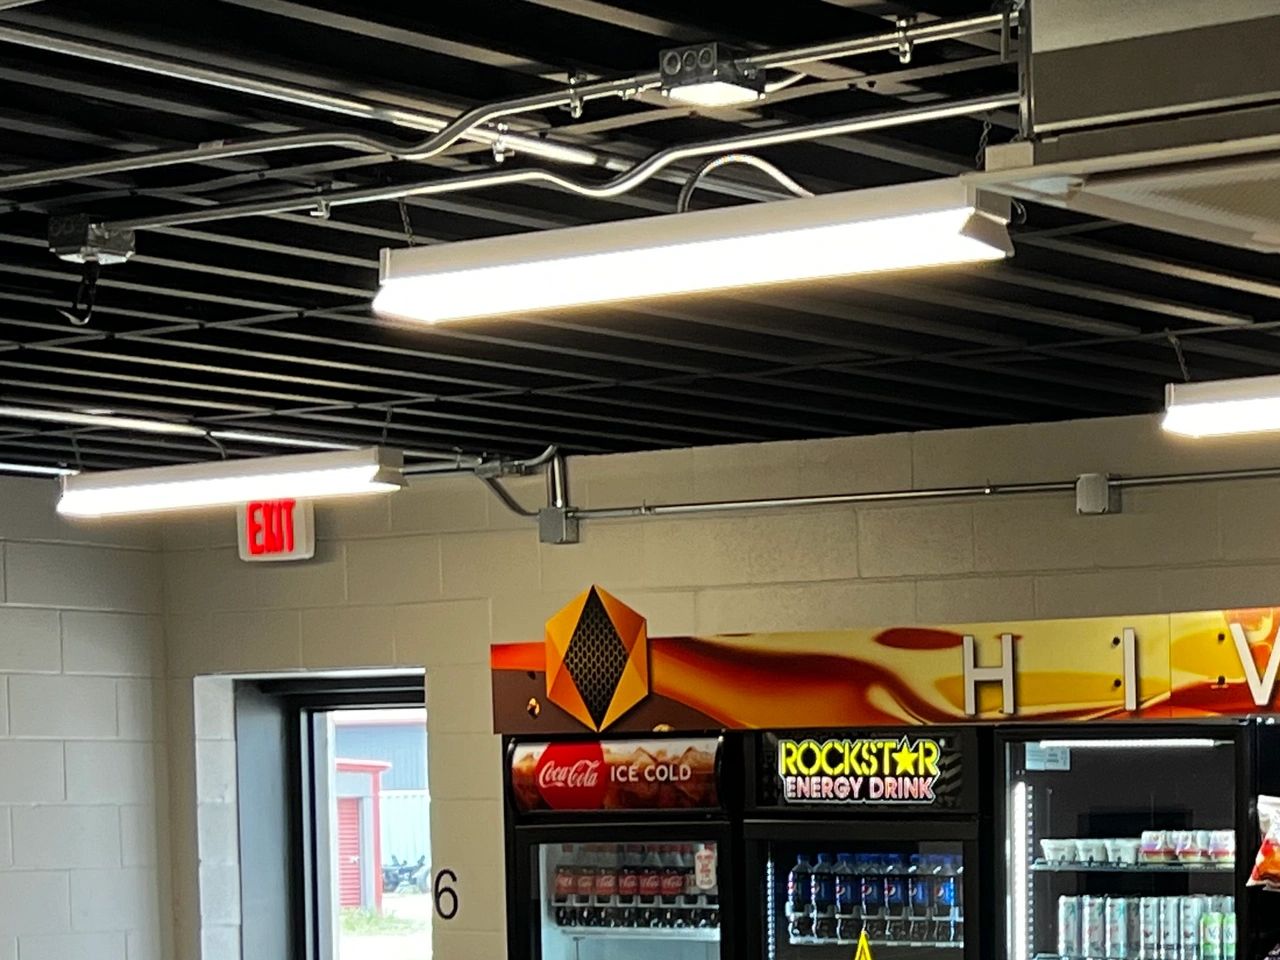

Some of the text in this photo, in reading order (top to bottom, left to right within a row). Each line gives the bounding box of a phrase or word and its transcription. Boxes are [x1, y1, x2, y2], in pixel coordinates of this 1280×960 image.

[246, 499, 296, 555] EXIT
[610, 764, 640, 783] ICE
[643, 763, 692, 782] COLD
[786, 776, 934, 800] ENERGY DRINK
[434, 868, 459, 920] 6
